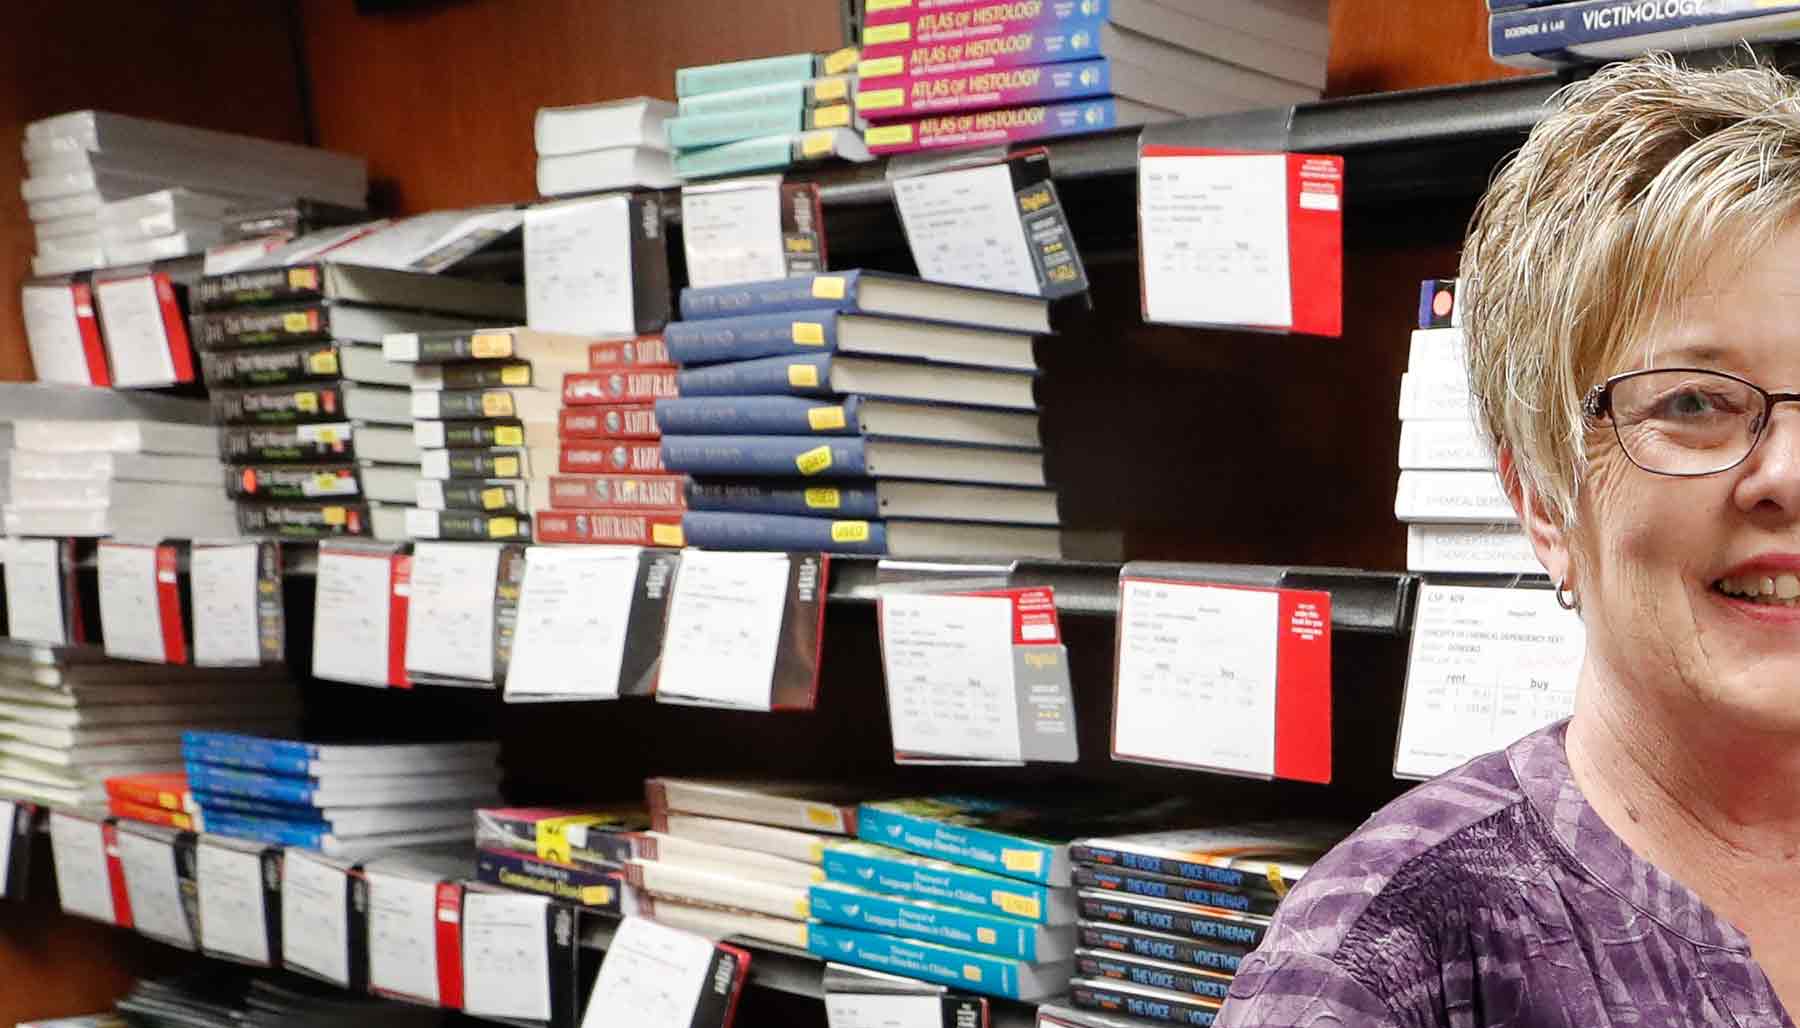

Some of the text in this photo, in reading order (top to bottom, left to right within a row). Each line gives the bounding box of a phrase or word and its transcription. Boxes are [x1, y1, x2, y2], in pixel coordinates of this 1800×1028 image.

[912, 78, 949, 96] ATLAS
[969, 69, 1040, 92] HISTOLOGY
[920, 116, 956, 133] ATLAS
[976, 107, 1046, 129] HISTOLOGY
